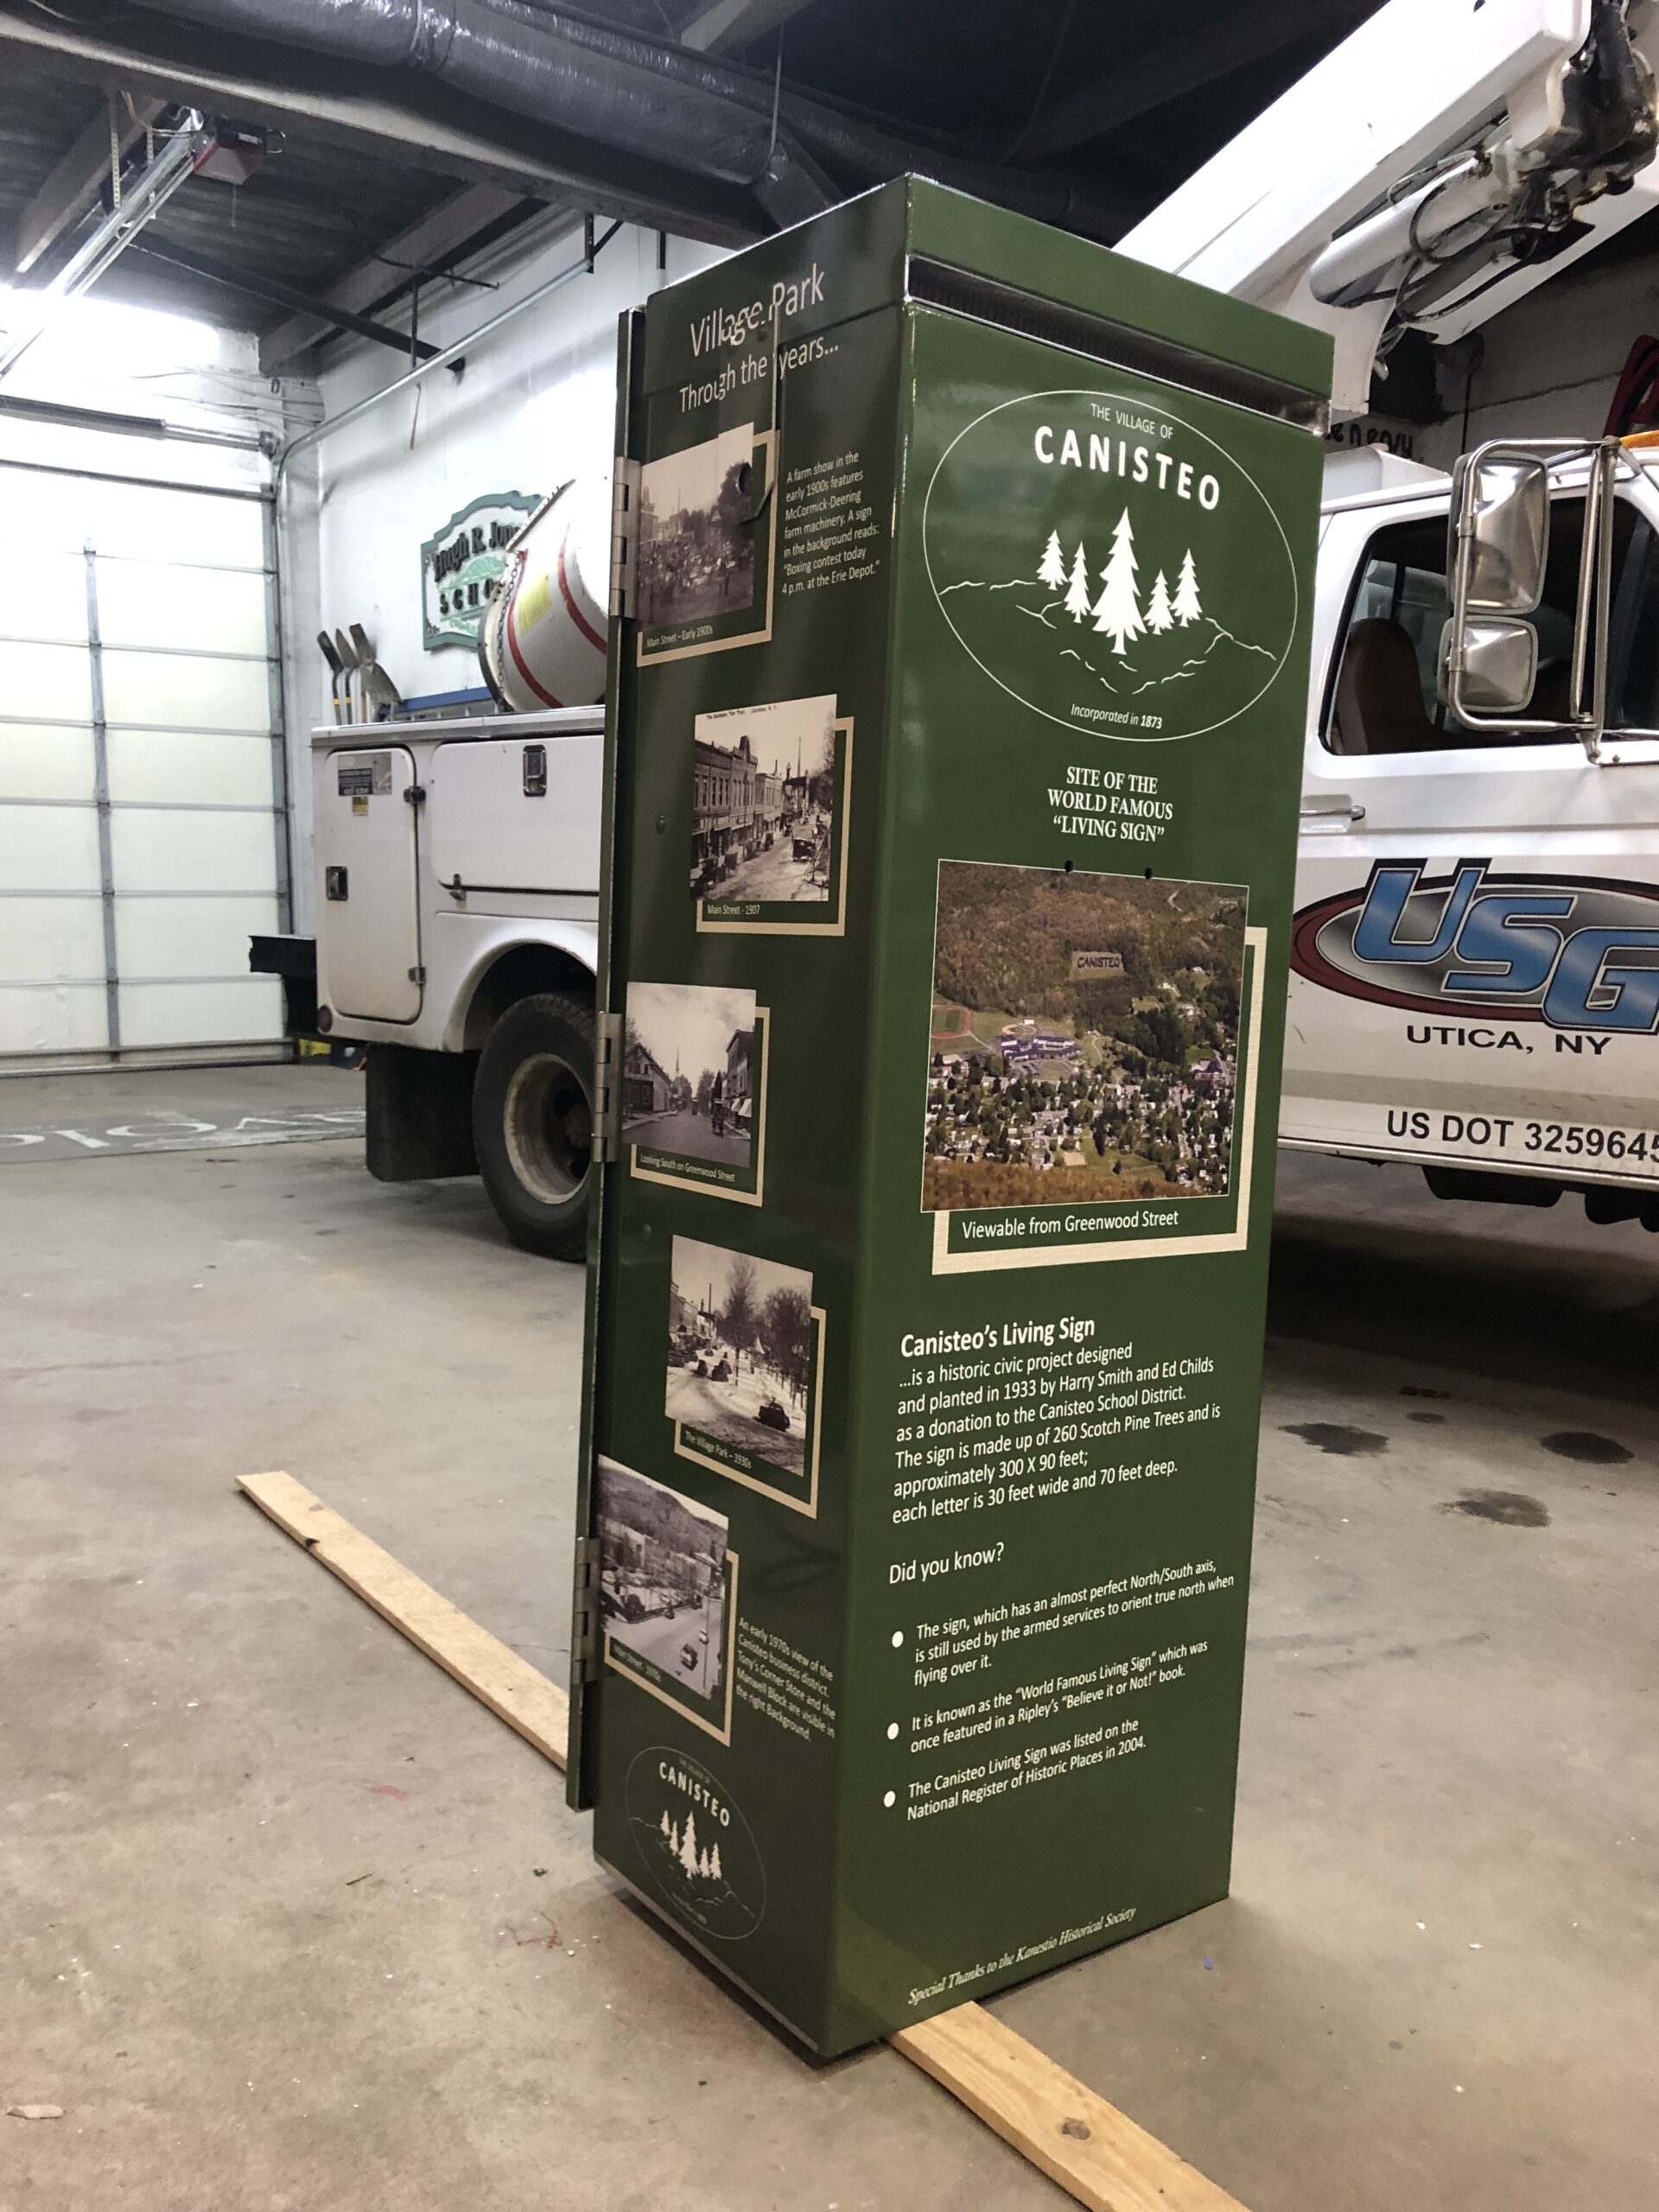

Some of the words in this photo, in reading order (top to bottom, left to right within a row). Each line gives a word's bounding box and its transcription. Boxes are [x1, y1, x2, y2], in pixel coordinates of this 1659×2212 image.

[690, 302, 763, 357] Village
[768, 262, 824, 321] Park
[679, 363, 735, 412] Through
[741, 353, 767, 385] the
[779, 336, 839, 380] years...
[1090, 403, 1110, 422] THE
[1116, 411, 1155, 435] VILLAGE
[1160, 424, 1173, 439] OF
[786, 472, 792, 484] A
[794, 467, 812, 481] farm
[813, 461, 835, 475] show
[836, 456, 843, 468] in
[845, 451, 859, 465] the
[1034, 424, 1221, 511] CANISTEO
[786, 486, 804, 502] early
[807, 480, 830, 496] 1900s
[830, 470, 863, 488] features
[785, 491, 861, 521] McCormick-Deering
[785, 526, 802, 539] farm
[804, 515, 845, 534] machinery.
[848, 510, 854, 522] A
[855, 506, 872, 521] sign
[784, 548, 791, 558] in
[792, 543, 805, 556] the
[806, 528, 852, 552] background
[854, 523, 879, 539] reads:
[783, 561, 811, 575] “Boxing
[813, 553, 842, 569] contest
[843, 546, 866, 562] today
[782, 582, 787, 594] 4
[788, 582, 805, 596] p.m.
[807, 577, 815, 589] at
[817, 574, 830, 587] the
[831, 570, 847, 584] Erie
[1071, 702, 1128, 726] Incorporated
[1130, 714, 1138, 725] in
[1141, 715, 1162, 728] 1873
[1066, 766, 1100, 787] SITE
[1103, 771, 1125, 790] OF
[1128, 774, 1158, 794] THE
[1047, 788, 1107, 812] WORLD
[1109, 797, 1173, 820] FAMOUS
[1053, 815, 1117, 838] “LIVING
[1120, 822, 1165, 842] SIGN”
[707, 904, 722, 914] Main
[722, 904, 741, 915] Street
[745, 904, 760, 916] 1907
[1077, 953, 1122, 969] CANISTEO
[1351, 857, 1659, 1035] USG
[1407, 1025, 1534, 1054] UTICA,
[1555, 1033, 1612, 1055] NY
[1387, 1109, 1430, 1140] US
[1442, 1115, 1514, 1147] DOT
[640, 1154, 661, 1167] Looking
[661, 1157, 677, 1170] South
[684, 1162, 717, 1178] Greenwood
[717, 1169, 735, 1183] Street
[963, 1217, 1026, 1239] Viewable
[1029, 1217, 1061, 1234] from
[1065, 1211, 1139, 1232] Greenwood
[1142, 1211, 1179, 1227] Street
[901, 1325, 997, 1357] Canisteo’s
[1003, 1320, 1055, 1346] Living
[1058, 1316, 1095, 1343] Sign
[899, 1369, 923, 1387] ...is
[926, 1370, 935, 1384] a
[939, 1360, 990, 1382] historic
[994, 1357, 1023, 1376] civic
[1027, 1351, 1073, 1375] project
[1077, 1341, 1132, 1365] designed
[898, 1393, 925, 1414] and
[930, 1386, 983, 1414] planted
[987, 1385, 999, 1402] in
[1004, 1379, 1036, 1400] 1933
[1040, 1377, 1056, 1397] by
[1059, 1376, 1095, 1392] Harry
[1097, 1367, 1133, 1387] Smith
[1136, 1363, 1159, 1382] and
[1162, 1360, 1177, 1377] Ed
[1179, 1357, 1213, 1376] Childs
[896, 1427, 912, 1442] as
[916, 1426, 925, 1439] a
[929, 1414, 992, 1437] donation
[995, 1412, 1010, 1427] to
[1014, 1406, 1035, 1424] the
[1039, 1400, 1094, 1421] Canisteo
[1097, 1389, 1138, 1412] School
[1141, 1386, 1185, 1405] District.
[889, 1560, 916, 1584] Did
[920, 1558, 949, 1582] you
[954, 1541, 1004, 1570] know?
[917, 1623, 939, 1640] The
[943, 1618, 969, 1636] sign,
[973, 1605, 1007, 1626] which
[1011, 1603, 1031, 1618] has
[1033, 1599, 1047, 1612] an
[1051, 1588, 1087, 1608] almost
[1090, 1579, 1128, 1602] perfect
[1130, 1562, 1193, 1589] North/South
[1195, 1559, 1217, 1574] axis,
[914, 1668, 948, 1687] flying
[950, 1659, 978, 1676] over
[981, 1655, 992, 1669] it.
[659, 1762, 730, 1827] CANISTEO
[907, 1791, 959, 1821] National
[962, 1780, 1009, 1804] Register
[1011, 1770, 1024, 1789] of
[1026, 1760, 1067, 1783] Historic
[1070, 1751, 1103, 1770] Places
[1106, 1745, 1116, 1759] in
[1118, 1735, 1146, 1756] 2004.
[907, 1976, 947, 2006] Special
[948, 1963, 985, 1989] Thanks
[986, 1961, 997, 1974] to
[998, 1953, 1014, 1969] the
[1058, 1916, 1104, 1946] Historical
[1104, 1908, 1136, 1928] Society
